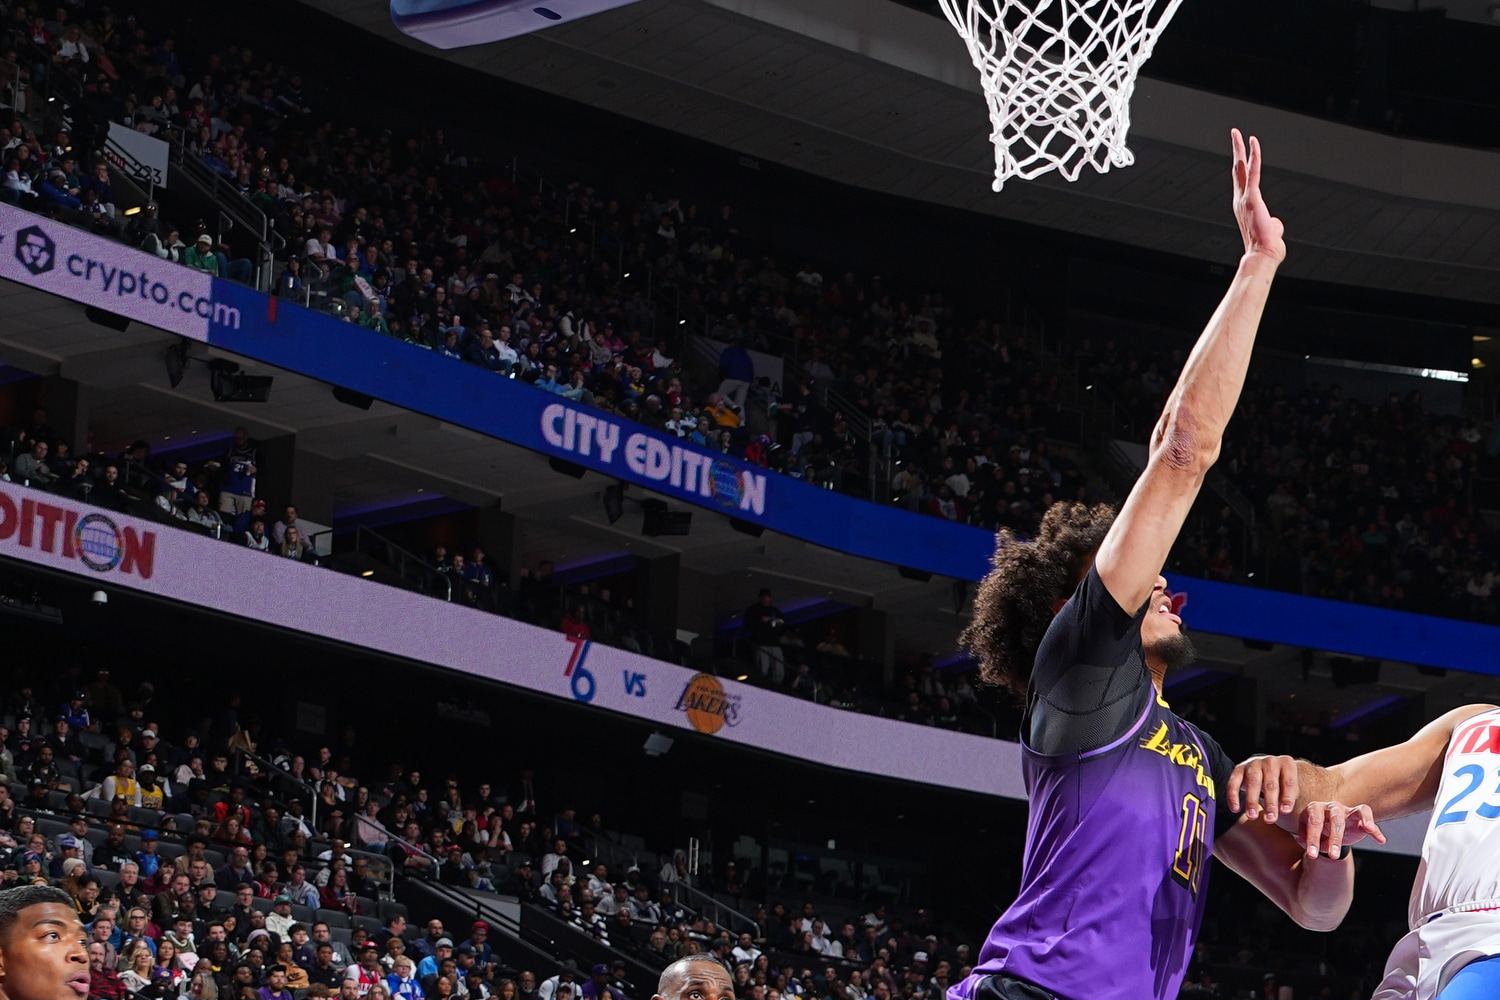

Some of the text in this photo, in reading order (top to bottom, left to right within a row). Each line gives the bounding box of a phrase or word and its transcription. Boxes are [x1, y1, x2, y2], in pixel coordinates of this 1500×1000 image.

[66, 253, 241, 330] crypto.com
[541, 403, 621, 464] CITY
[623, 669, 646, 697] VS
